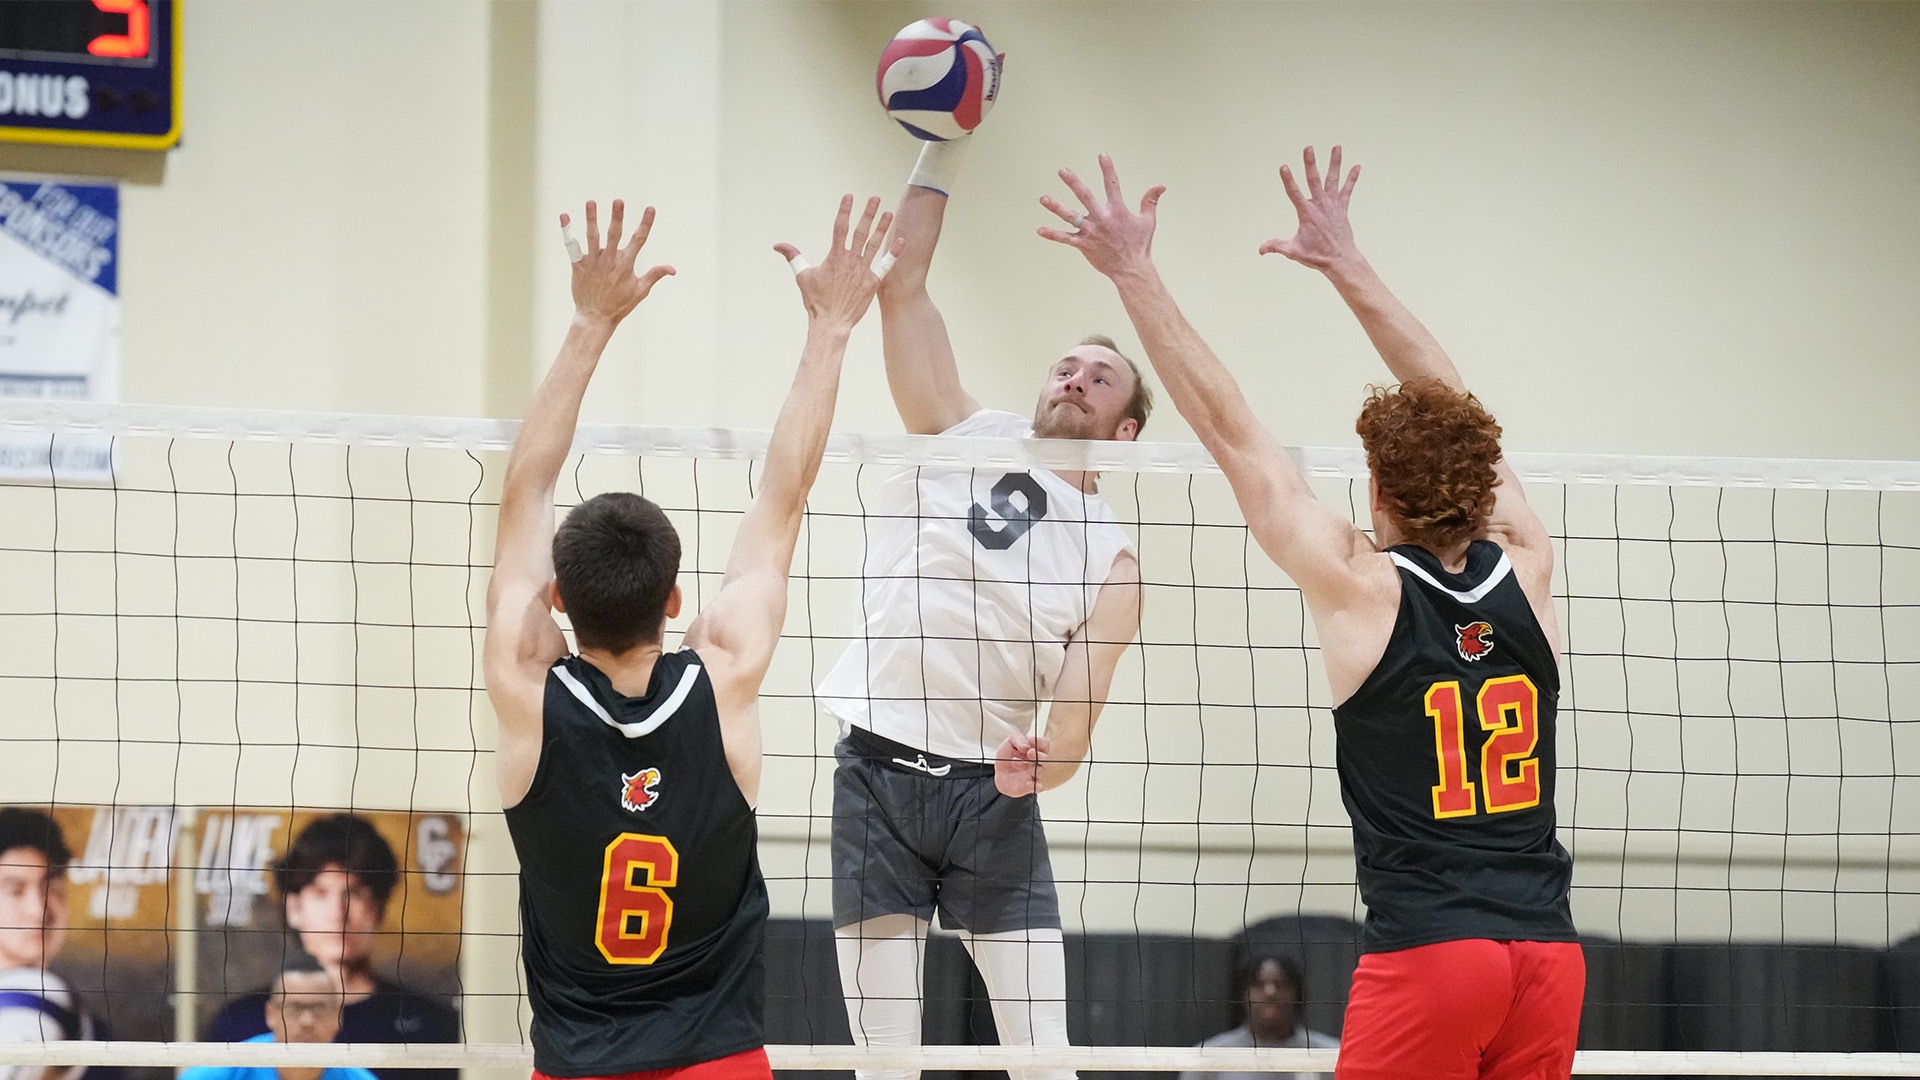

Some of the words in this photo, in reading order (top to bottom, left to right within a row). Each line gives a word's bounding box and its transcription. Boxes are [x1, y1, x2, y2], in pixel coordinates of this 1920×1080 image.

[967, 472, 1047, 550] 9
[1424, 674, 1540, 819] 12
[594, 831, 679, 965] 6
